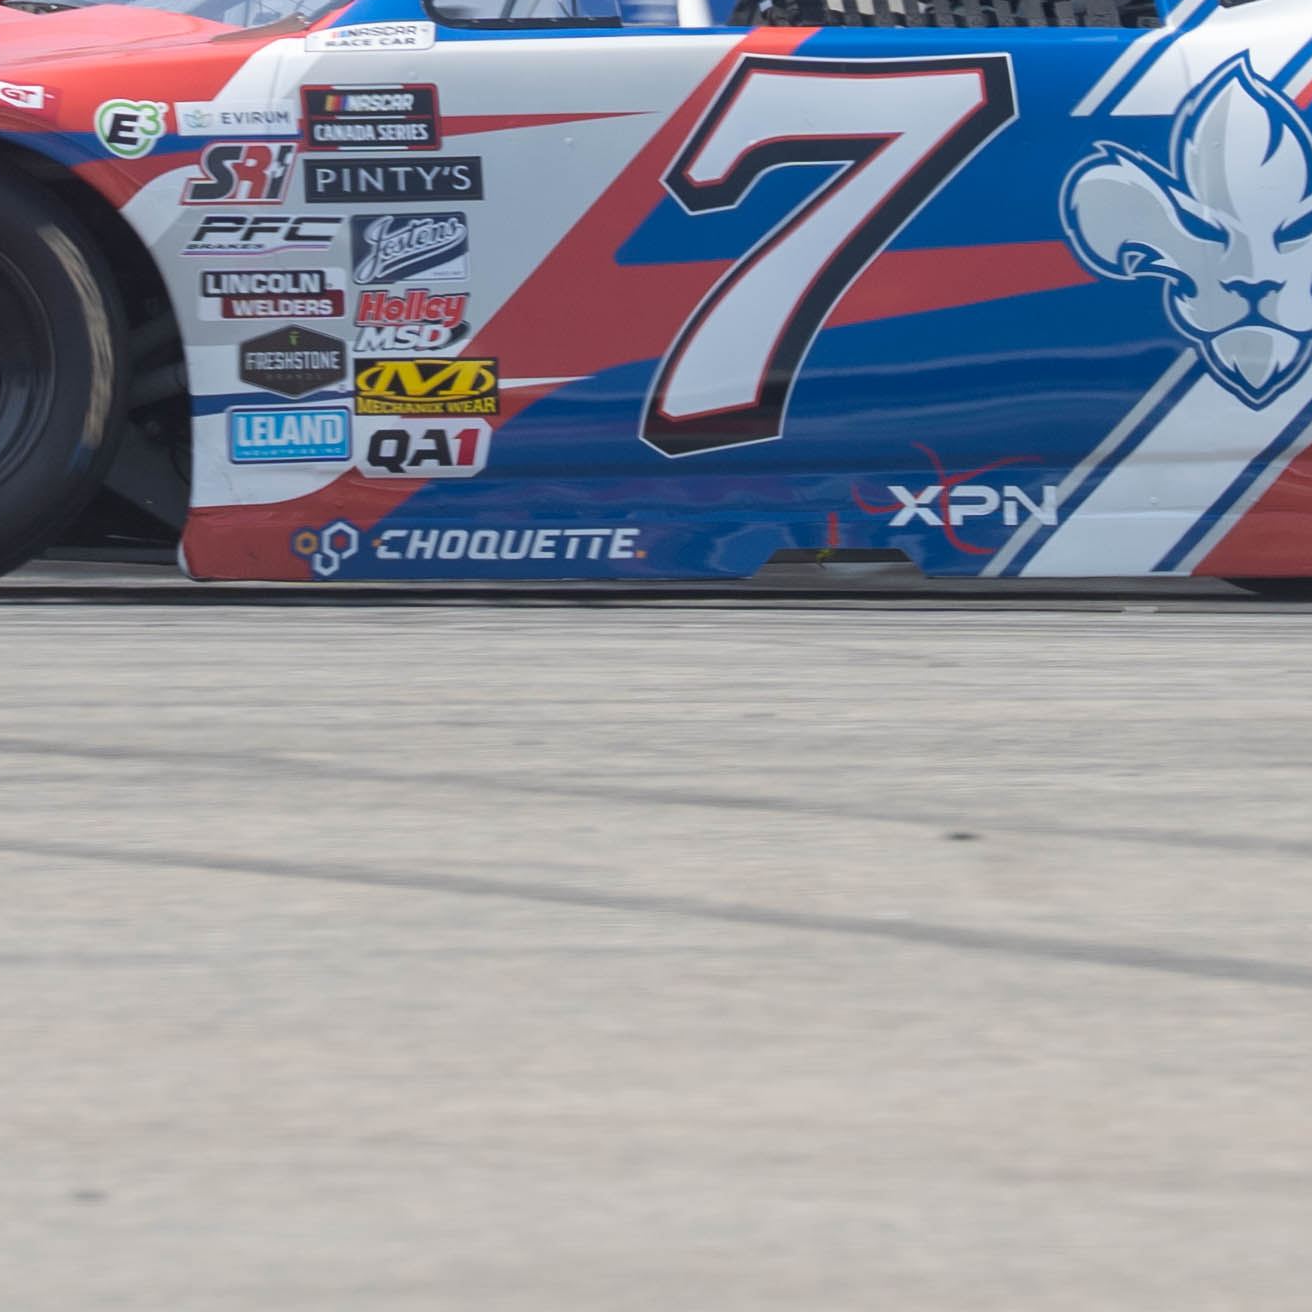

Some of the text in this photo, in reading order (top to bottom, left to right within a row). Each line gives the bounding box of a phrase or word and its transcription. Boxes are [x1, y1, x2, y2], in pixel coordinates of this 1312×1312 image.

[325, 36, 417, 48] RACE CAR
[346, 24, 418, 38] NASCAR
[345, 93, 415, 112] NASCAR
[221, 111, 291, 125] EVIRUM
[313, 123, 429, 143] CANADA SERIES
[316, 166, 472, 193] PINTY'S
[192, 216, 343, 242] PFC
[639, 53, 1020, 459] 7
[206, 272, 321, 294] LINCOLN
[232, 299, 333, 316] WELDERS
[358, 290, 468, 327] Holley
[354, 324, 453, 351] MSD
[245, 351, 342, 370] FRESHSTONE
[357, 397, 497, 413] MECHANIX WEAR
[237, 415, 343, 446] LELAND
[367, 428, 481, 474] QA1
[887, 485, 1058, 526] XPN
[376, 528, 641, 559] CHOQUETTE
